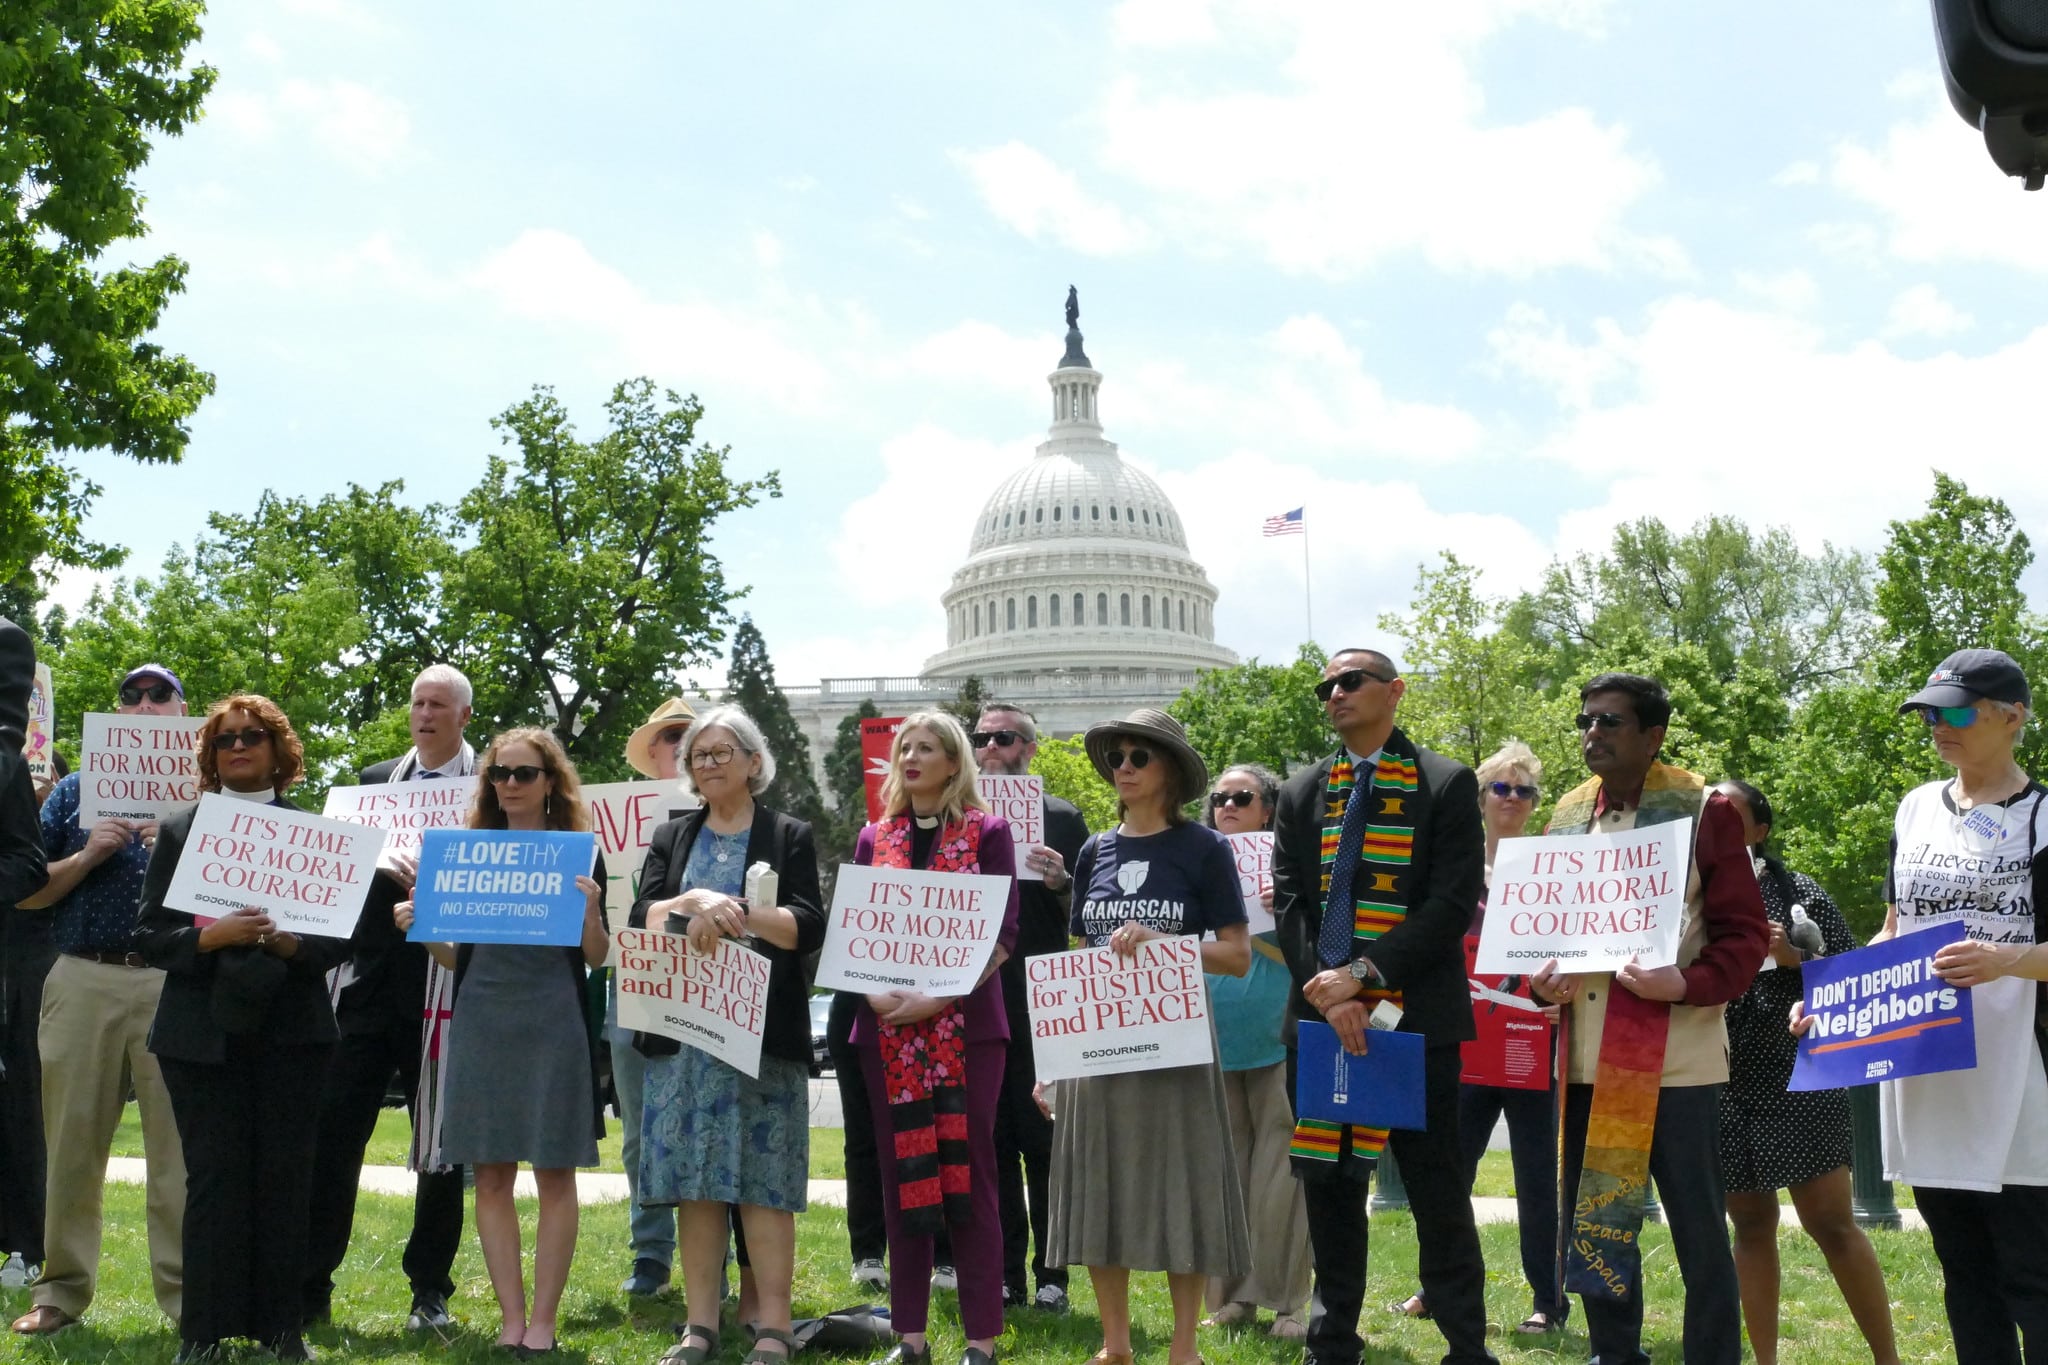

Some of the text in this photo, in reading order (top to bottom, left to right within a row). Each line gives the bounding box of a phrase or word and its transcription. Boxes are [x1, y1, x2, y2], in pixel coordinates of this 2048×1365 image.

[106, 727, 142, 749] IT'S
[89, 752, 199, 777] FOR MOR
[97, 778, 198, 801] COURAG
[357, 788, 463, 811] IT'S TIME
[97, 810, 156, 820] SOJOURNERS
[1963, 818, 1995, 840] ACTION
[1970, 809, 1996, 829] FAITH
[230, 812, 280, 841] IT'S
[287, 824, 354, 856] TIME
[196, 833, 360, 885] FOR MORAL
[1531, 841, 1661, 875] IT'S TIME
[1929, 852, 1990, 874] never
[201, 862, 342, 907] COURAGE
[433, 869, 563, 896] NEIGHBOR
[1500, 871, 1674, 906] FOR MORAL
[1926, 869, 1951, 882] cost
[1954, 873, 1977, 890] my
[194, 893, 330, 925] SOJOURNS SojoAction
[439, 902, 549, 920] (NO EXCEPTIONS)
[868, 882, 982, 912] IT'S TIME
[840, 907, 989, 941] FOR MORAL
[1084, 920, 1116, 935] USTICE
[1509, 904, 1659, 937] COURAGE
[1954, 911, 1978, 920] MAKE
[848, 936, 974, 968] COURAGE
[1506, 950, 1588, 959] SOJOURNERS
[620, 950, 764, 1009] for JUSTICE
[843, 969, 916, 987] SOJOURNERS
[1032, 965, 1199, 1009] for JUSTICE
[1861, 959, 1922, 998] DEPORT
[621, 977, 762, 1036] and PEACE
[1035, 991, 1204, 1038] and PEACE
[1808, 988, 1958, 1040] Neighbors
[664, 1015, 726, 1044] SOJOURNERS
[1082, 1043, 1160, 1059] SOJOURNERS
[1865, 1067, 1888, 1079] ACTION
